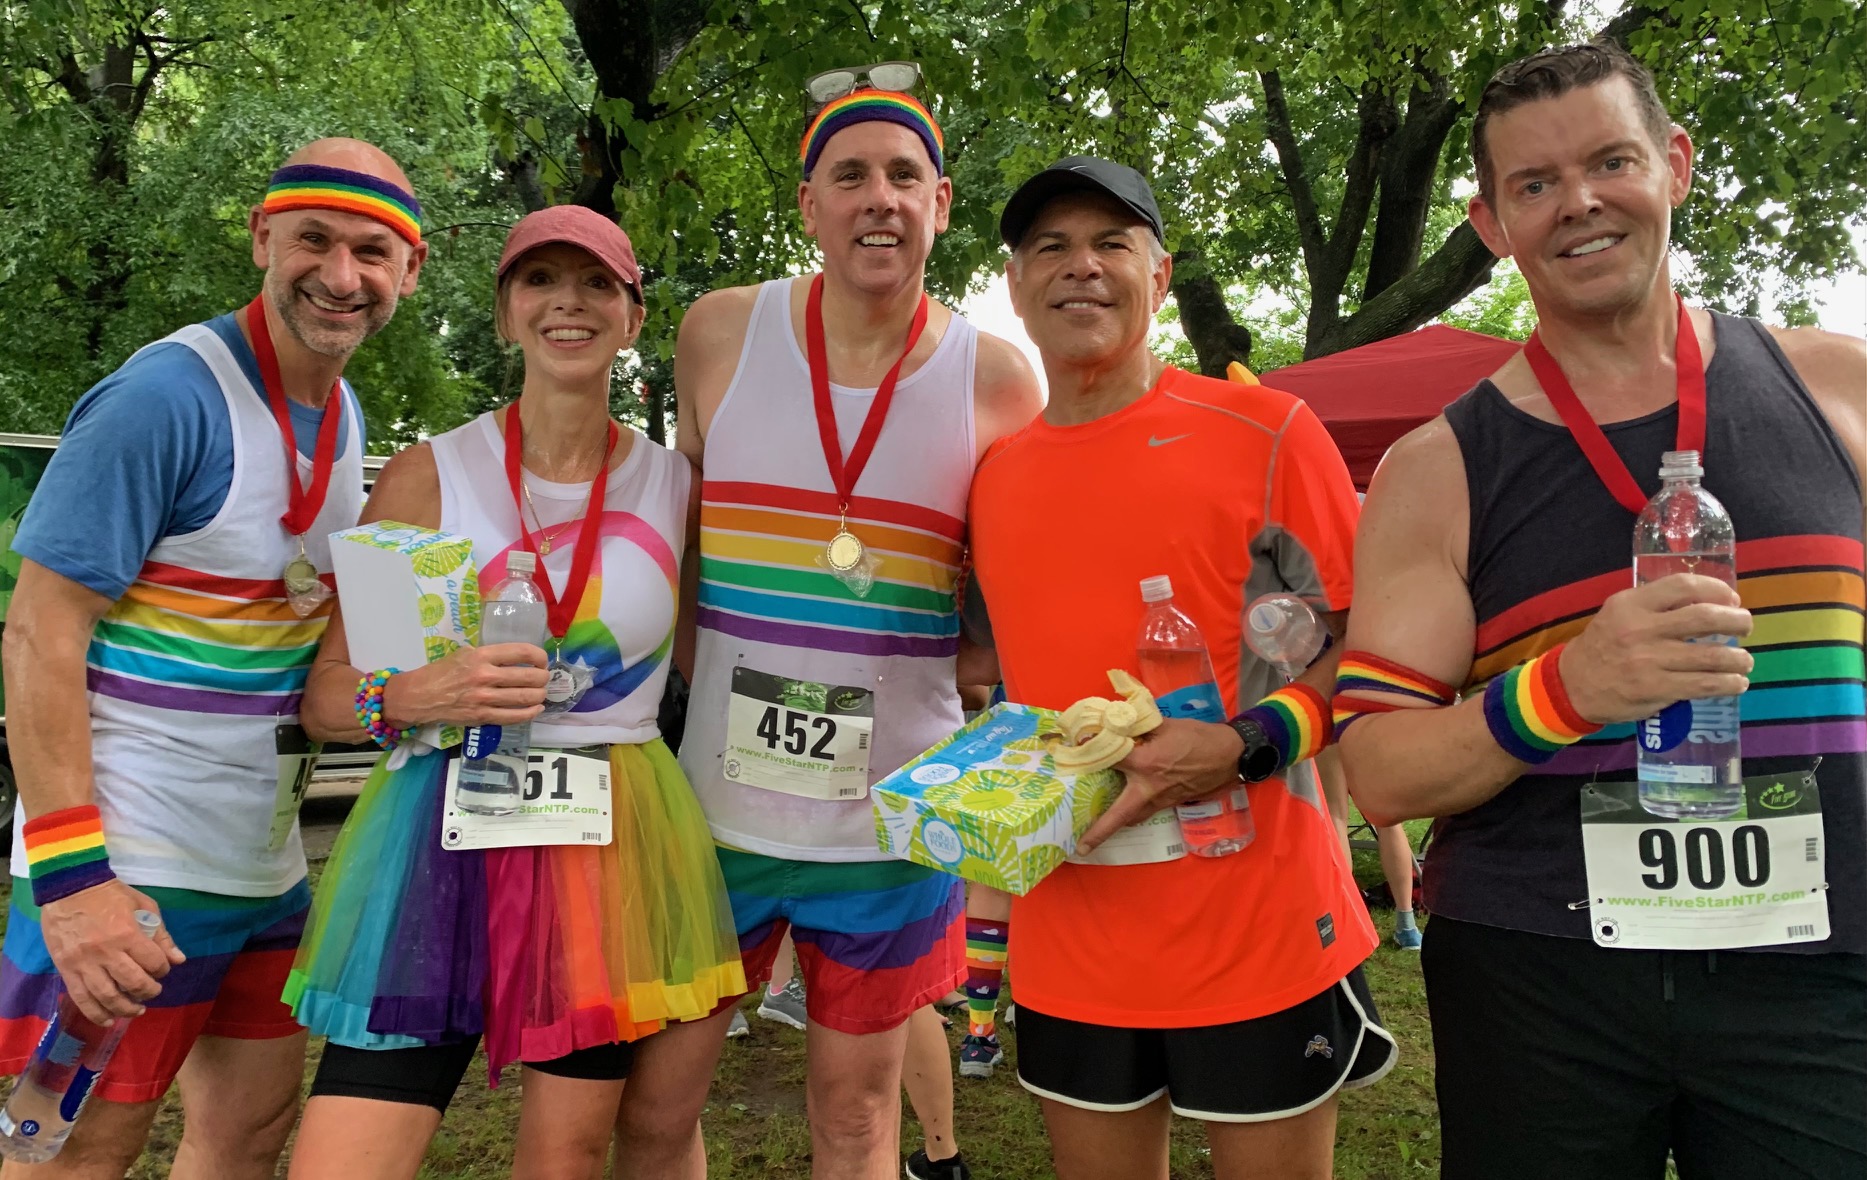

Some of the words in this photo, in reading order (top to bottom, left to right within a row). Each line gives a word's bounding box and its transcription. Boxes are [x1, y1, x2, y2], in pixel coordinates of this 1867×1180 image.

[445, 592, 464, 634] peach
[756, 706, 837, 761] 452
[523, 755, 573, 801] 51
[736, 745, 856, 773] www.FiveStarNTP.com
[1638, 825, 1771, 891] 900
[1607, 889, 1806, 908] www.FiveStarNTP.com
